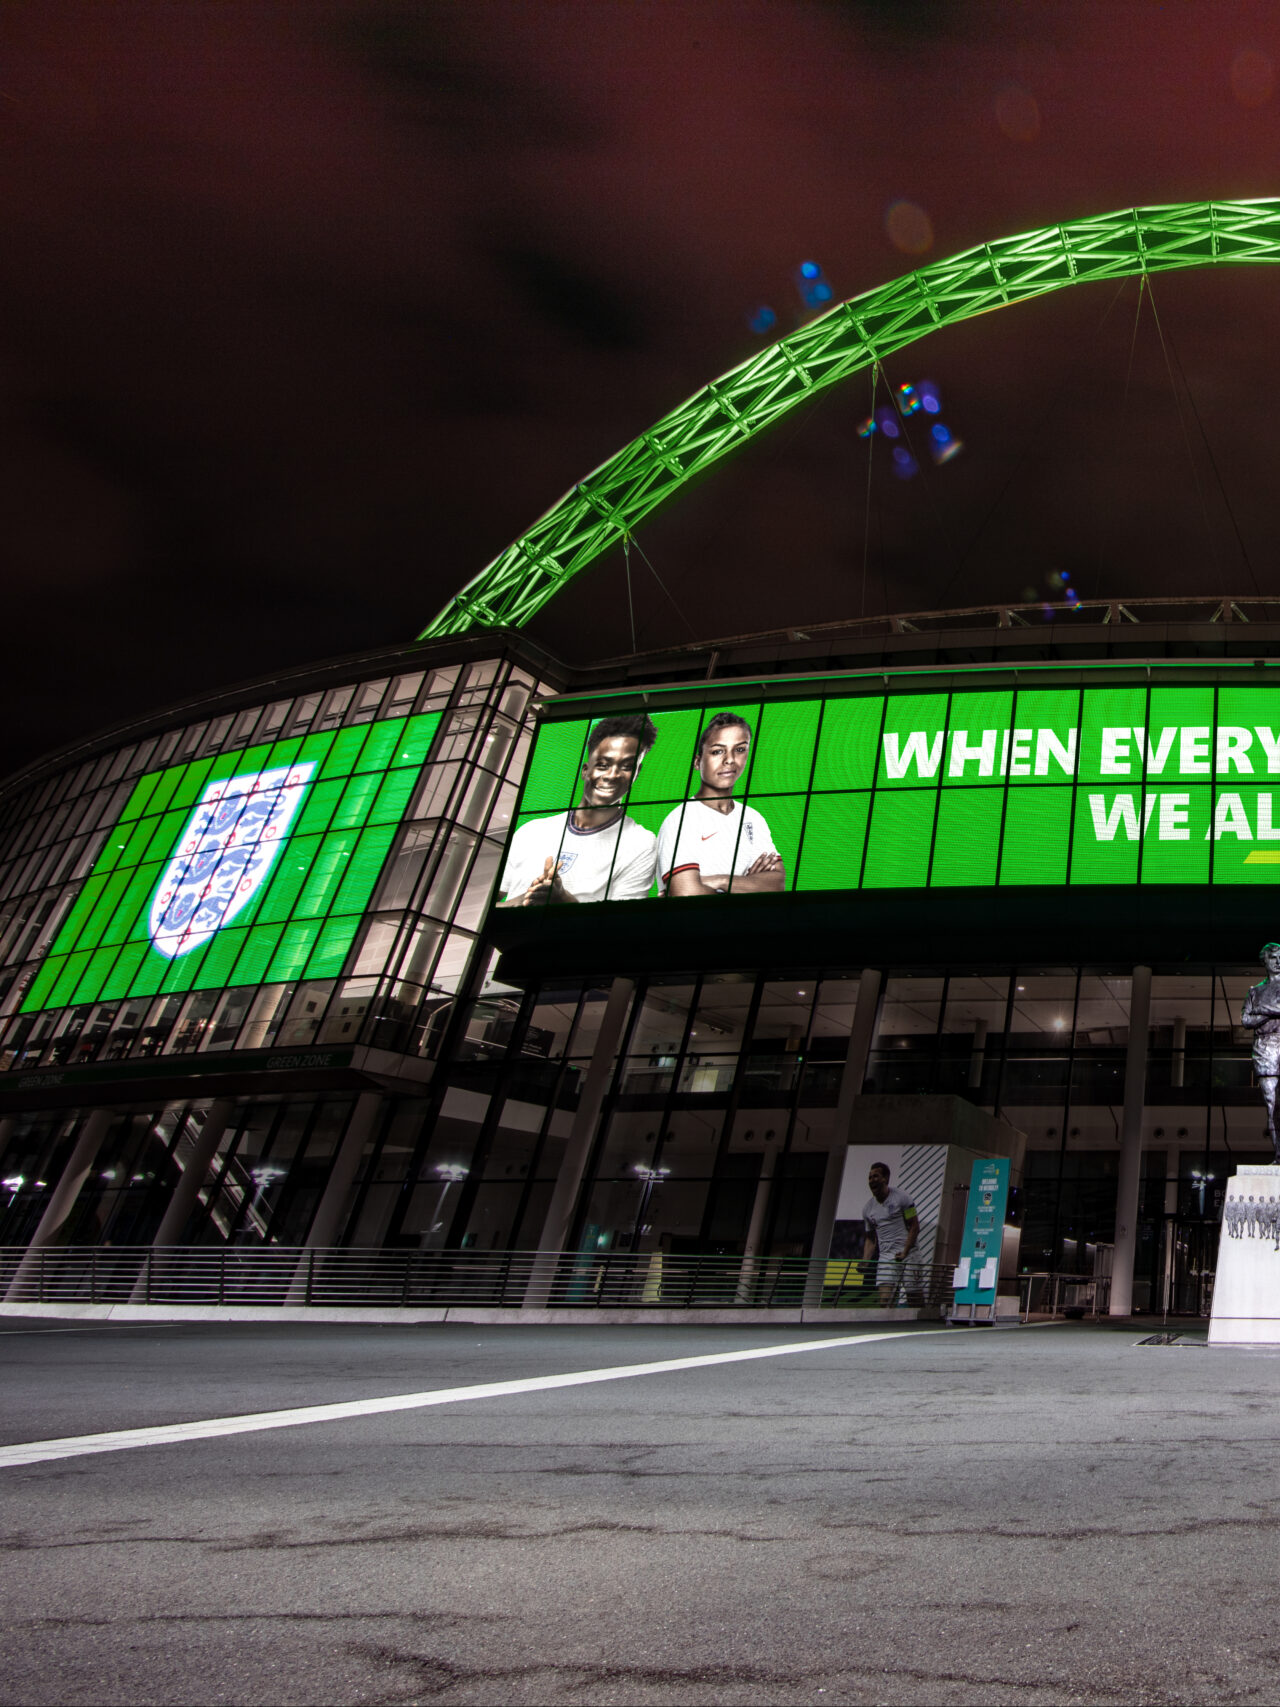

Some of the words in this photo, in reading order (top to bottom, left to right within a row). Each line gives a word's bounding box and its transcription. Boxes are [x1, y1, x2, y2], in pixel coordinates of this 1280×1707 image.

[884, 729, 1080, 778] WHEN
[1089, 793, 1192, 842] WE
[267, 1055, 300, 1069] GREEN
[300, 1054, 333, 1067] ZONE
